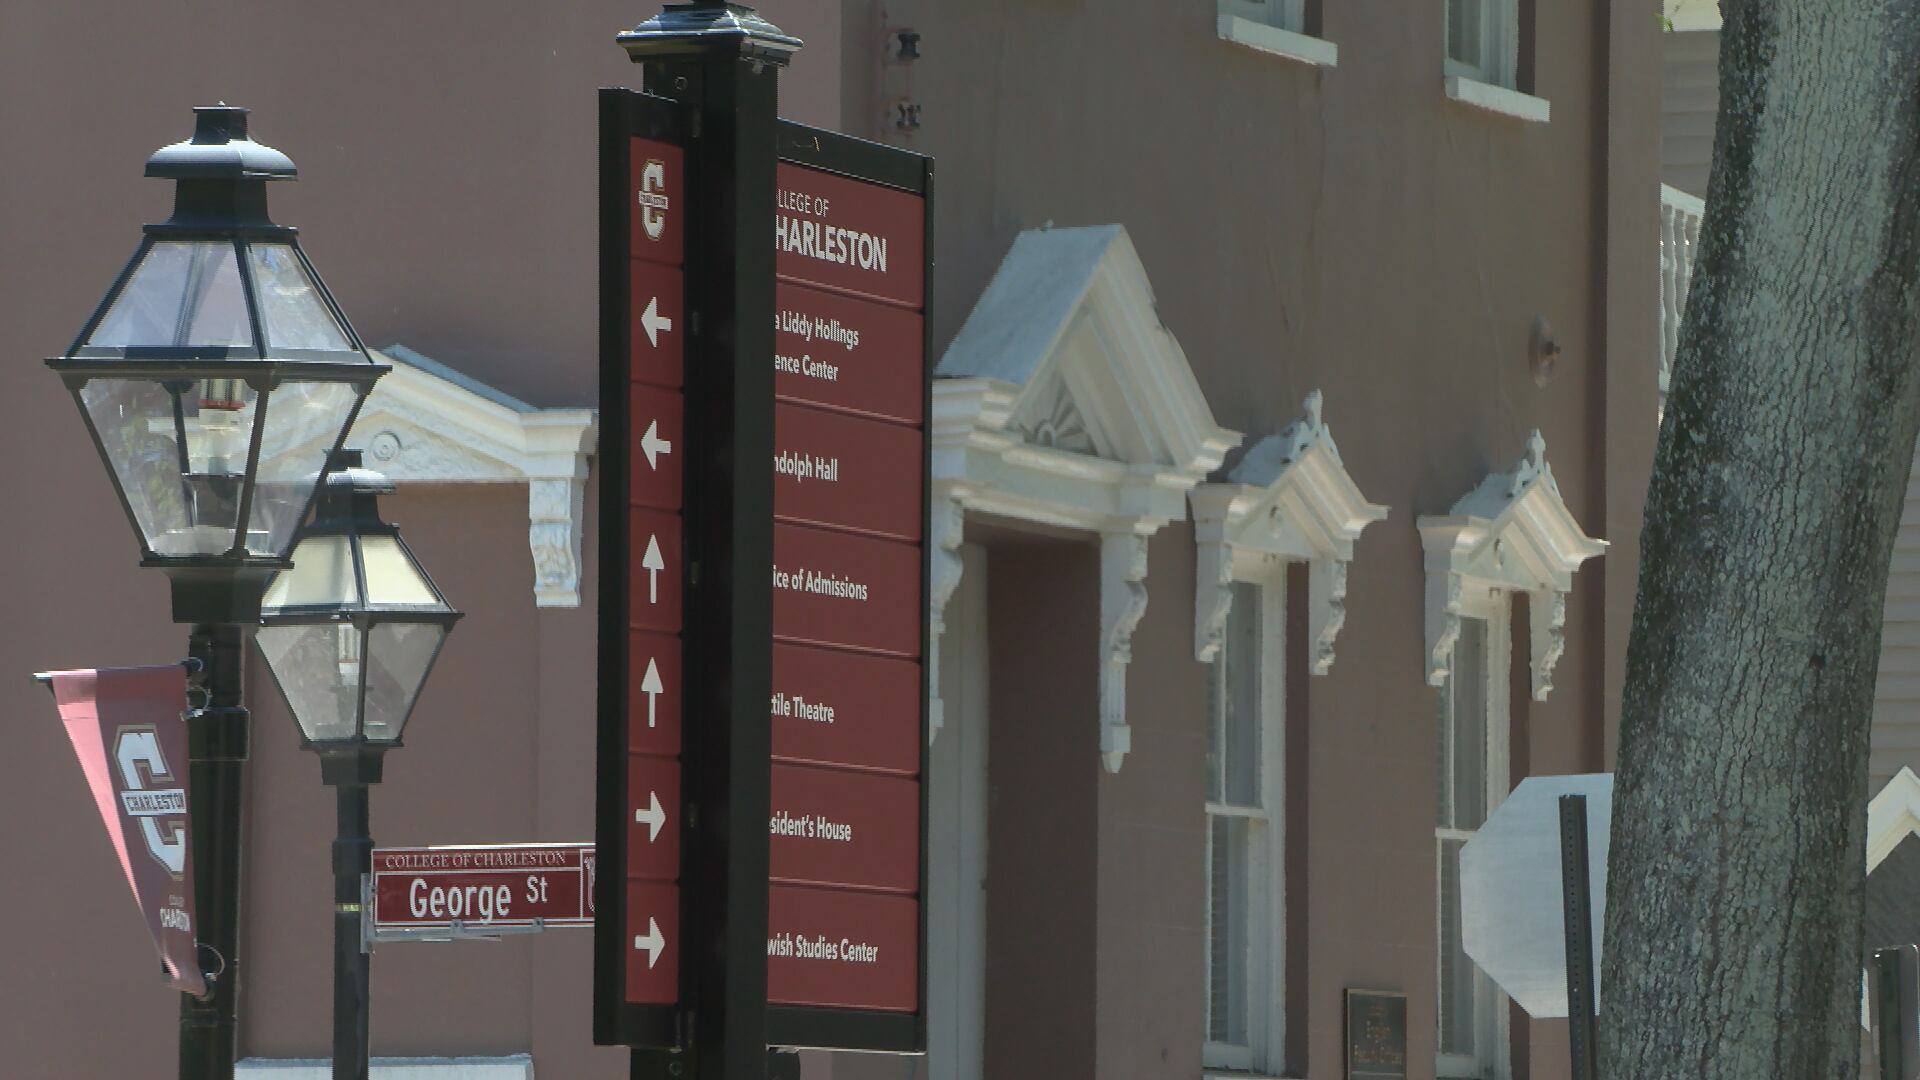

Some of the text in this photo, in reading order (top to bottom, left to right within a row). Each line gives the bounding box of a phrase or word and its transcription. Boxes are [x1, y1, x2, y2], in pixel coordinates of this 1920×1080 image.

[776, 189, 829, 217] LLEGE OF
[776, 215, 887, 272] HARLESTON
[782, 310, 813, 341] Liddy
[815, 316, 859, 350] Hollings
[775, 354, 839, 381] ence Center
[815, 456, 838, 482] Hall
[791, 568, 804, 591] of
[805, 570, 868, 601] Admissions
[771, 692, 835, 723] tile Theatre
[125, 793, 186, 811] CHARLESTON
[769, 810, 852, 841] sident's House
[385, 850, 567, 868] COLLEGE OF CHARLESTON
[409, 874, 549, 924] George St
[795, 934, 838, 960] Studies
[840, 938, 879, 962] Center
